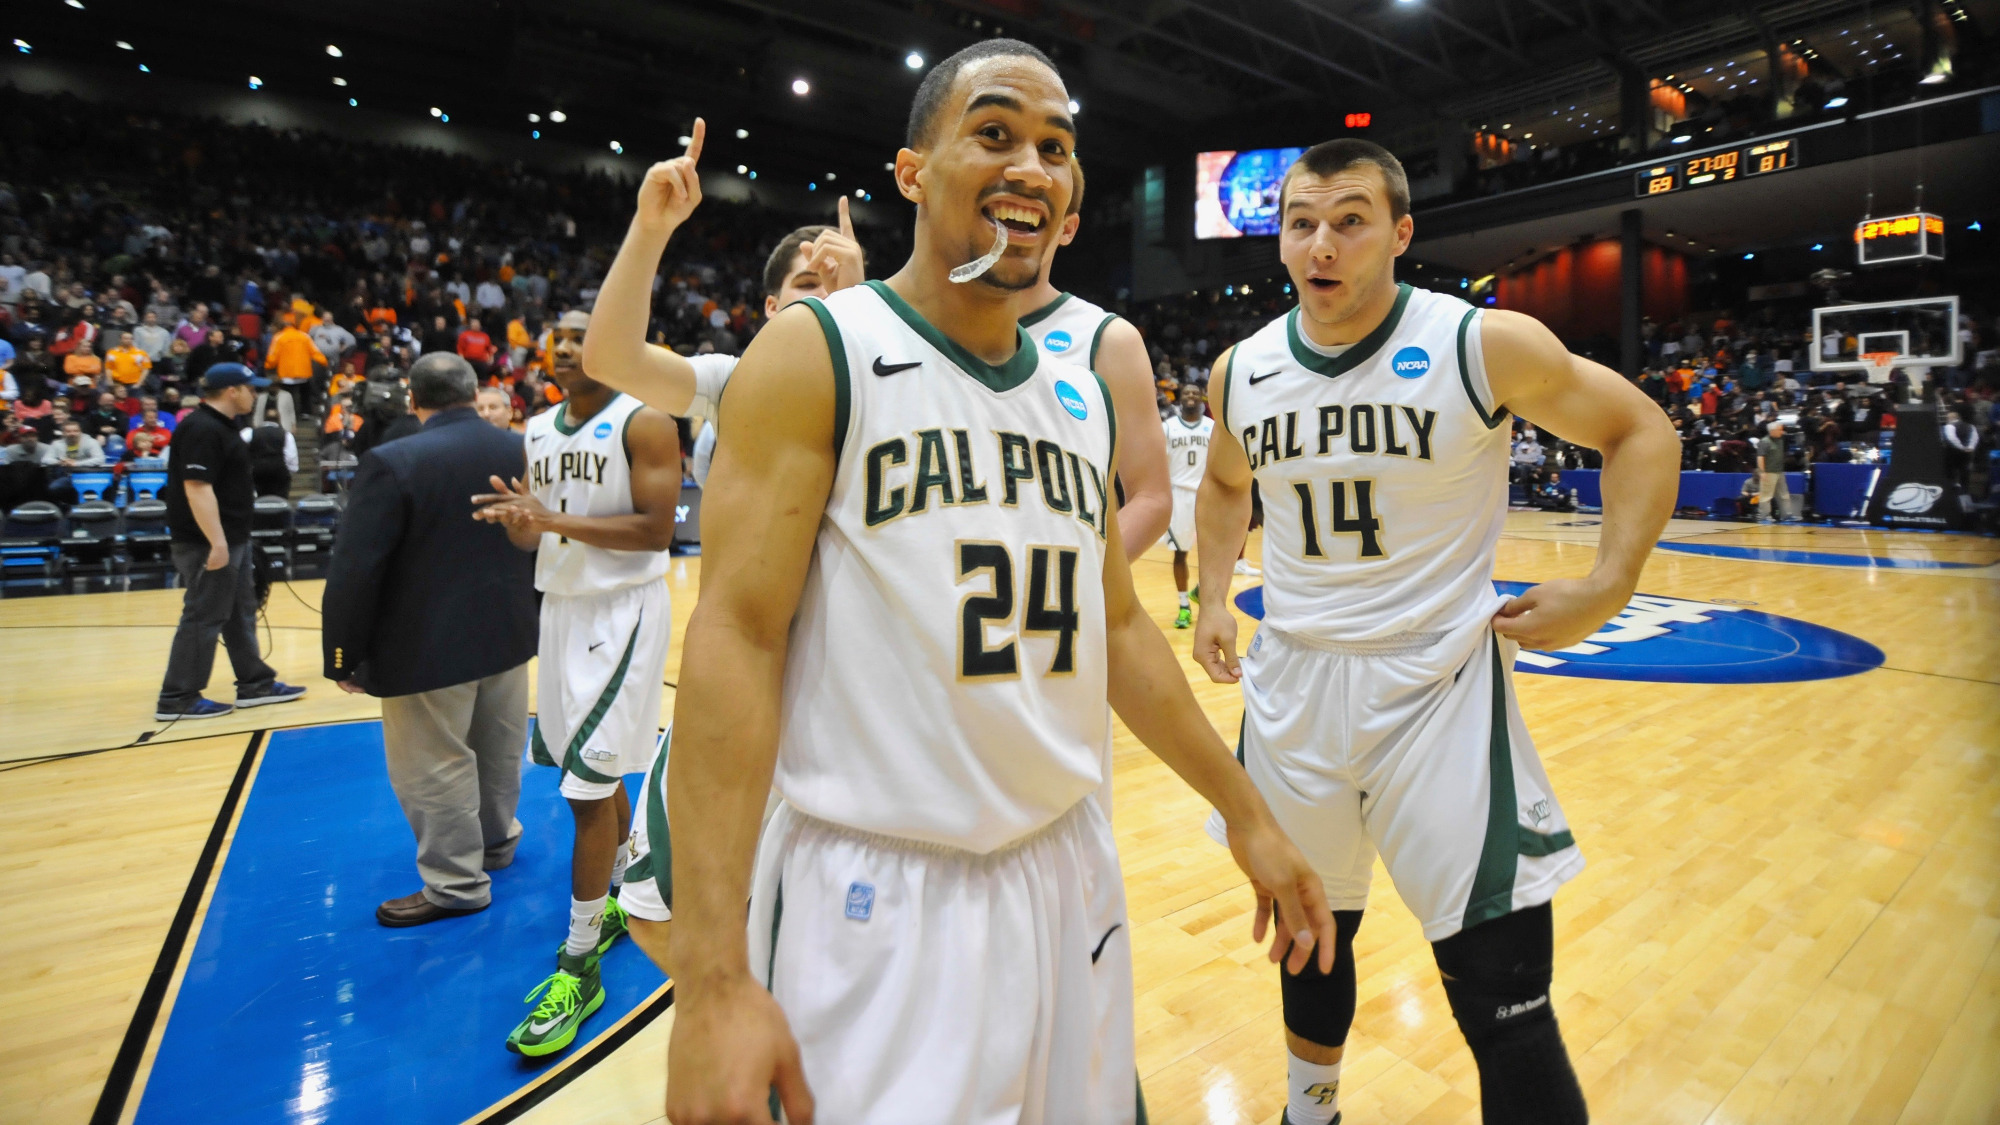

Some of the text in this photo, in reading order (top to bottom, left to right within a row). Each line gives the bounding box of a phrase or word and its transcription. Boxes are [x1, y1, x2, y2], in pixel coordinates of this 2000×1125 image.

[1686, 151, 1739, 176] 27:00
[1723, 168, 1736, 181] 2
[1759, 152, 1787, 172] 81
[1648, 175, 1673, 195] 69
[1397, 360, 1428, 371] NCAA
[1243, 402, 1440, 472] CAL POLY
[531, 456, 553, 492] AL
[863, 427, 989, 530] CAL
[1289, 476, 1389, 561] 14
[954, 538, 1081, 684] 24
